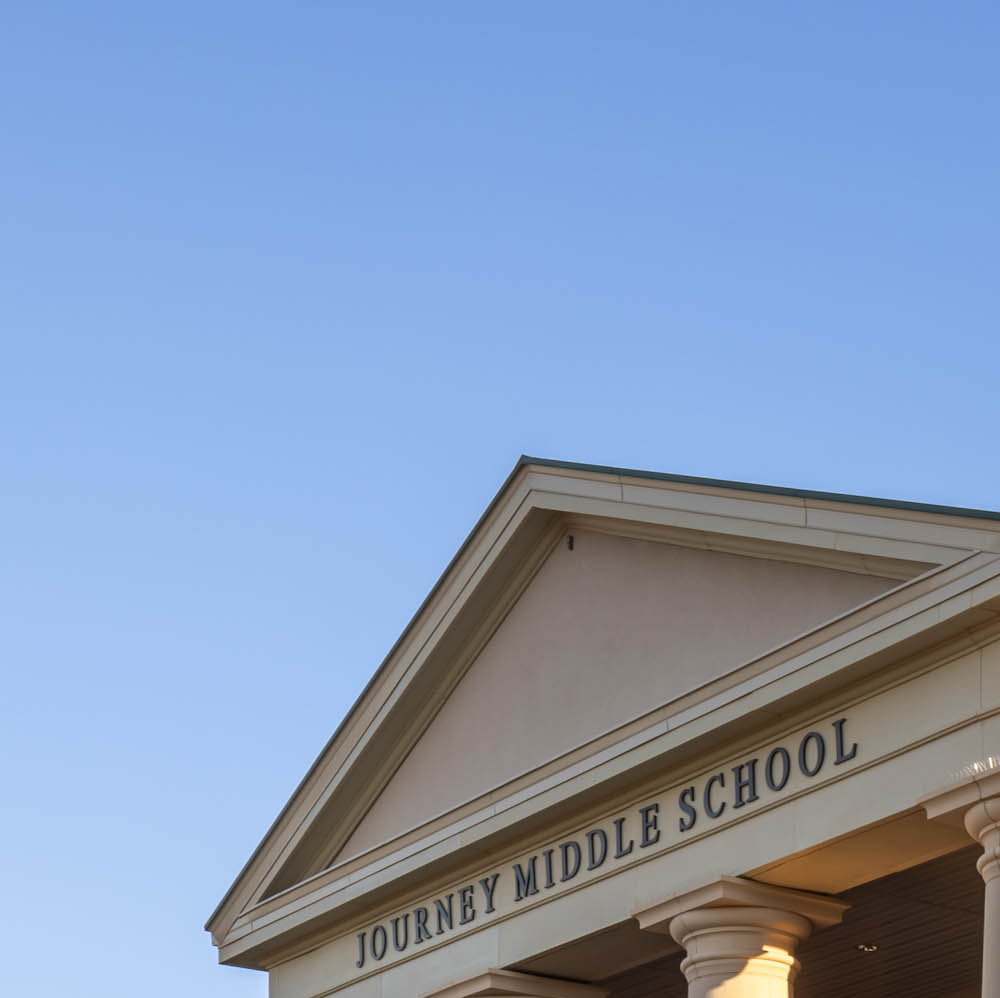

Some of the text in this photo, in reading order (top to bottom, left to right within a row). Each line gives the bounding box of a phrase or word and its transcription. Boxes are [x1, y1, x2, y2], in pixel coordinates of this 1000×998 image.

[356, 718, 858, 968] JOURNEY MIDDLE SCHOOL
